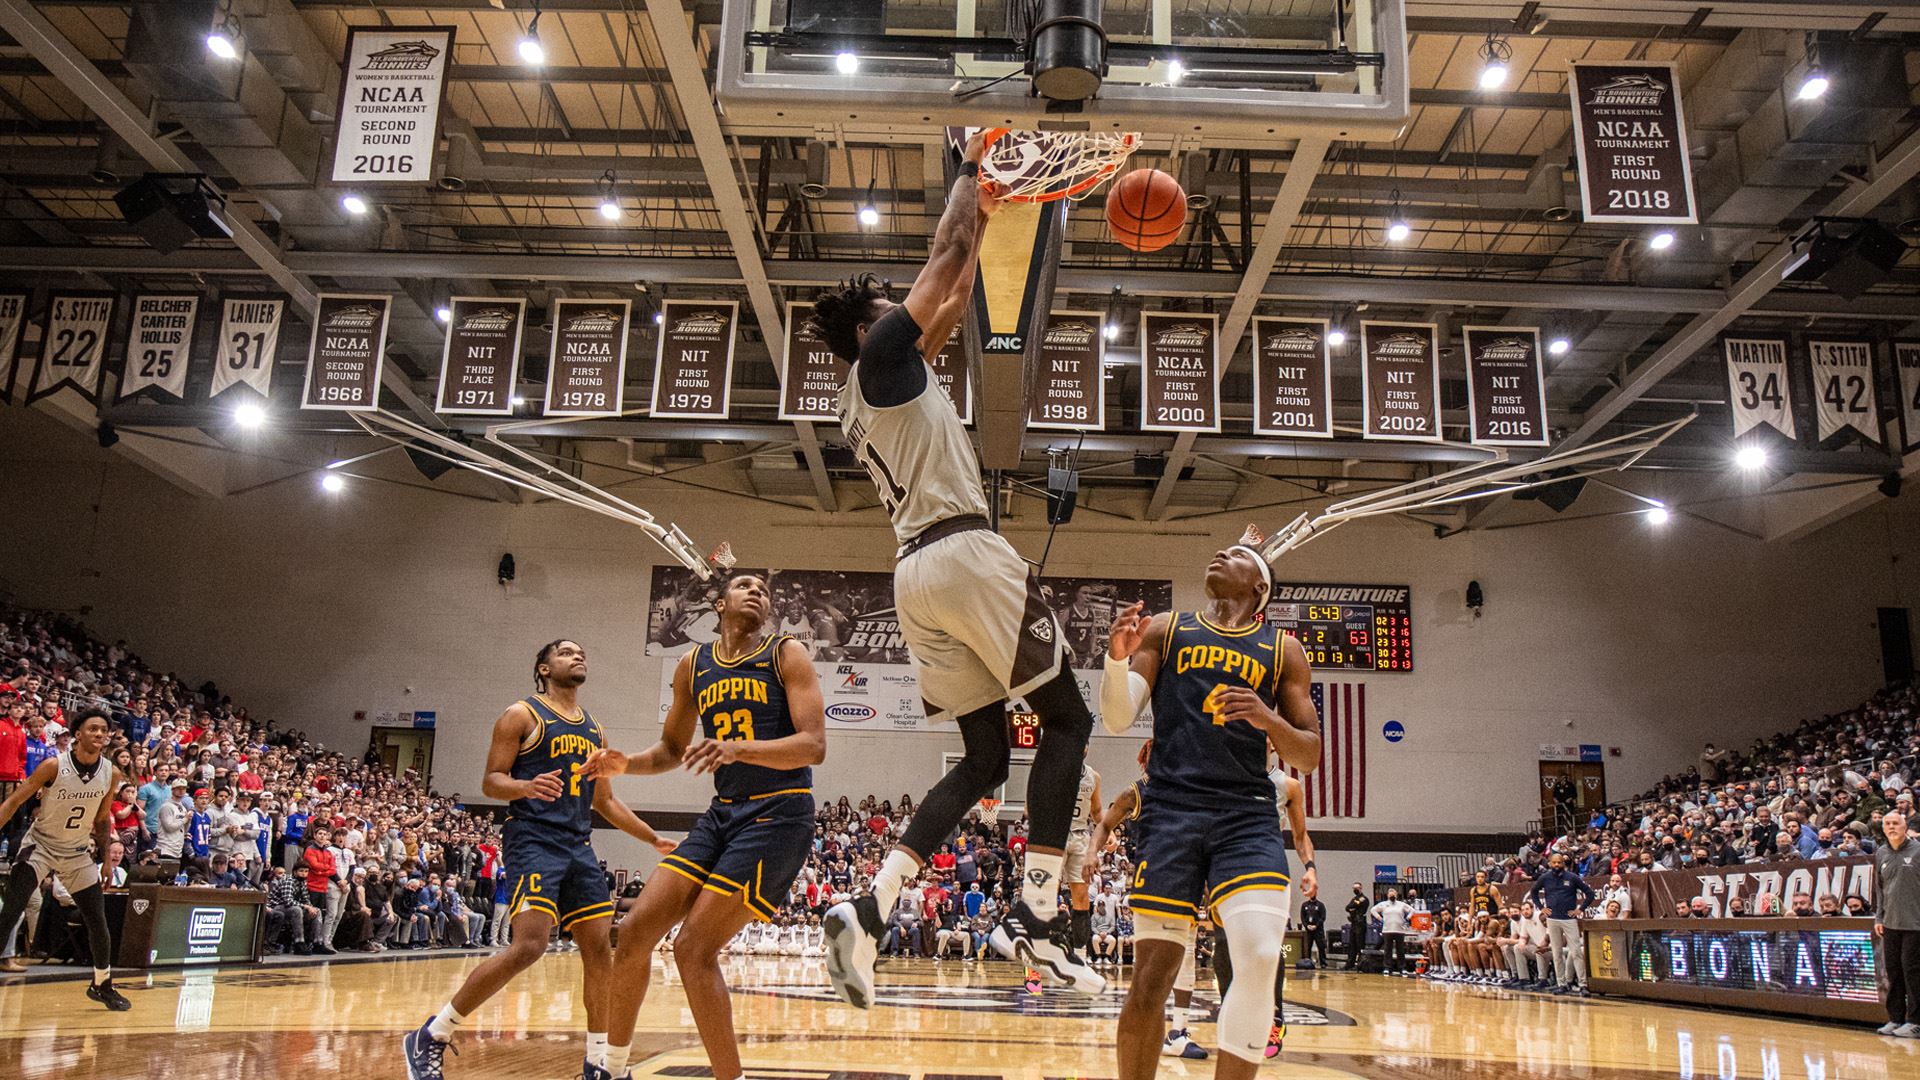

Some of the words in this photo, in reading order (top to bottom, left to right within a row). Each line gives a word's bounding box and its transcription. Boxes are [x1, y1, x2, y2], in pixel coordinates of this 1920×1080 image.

[367, 61, 429, 70] BONNIES
[360, 87, 424, 103] NCAA
[1594, 96, 1659, 104] BONNIES
[354, 105, 428, 113] TOURNAMENT
[361, 120, 416, 131] SECOND
[1597, 121, 1664, 138] NCAA
[362, 134, 411, 145] ROUND
[1594, 139, 1671, 149] TOURNAMENT
[353, 154, 414, 174] 2016
[1613, 155, 1656, 166] FIRST
[1611, 169, 1661, 180] ROUND
[1608, 189, 1671, 209] 2018
[54, 300, 67, 321] S.
[70, 301, 109, 322] STITH
[140, 300, 192, 313] BELCHER
[229, 302, 275, 324] LANIER
[140, 315, 187, 329] CARTER
[140, 330, 182, 344] HOLLIS
[325, 337, 369, 350] NCAA
[985, 336, 1022, 350] ANC
[51, 329, 97, 367] 22
[229, 331, 266, 370] 31
[467, 346, 496, 359] NIT
[566, 342, 611, 356] NCAA
[1729, 342, 1783, 364] MARTIN
[681, 350, 709, 362] NIT
[808, 352, 834, 364] NIT
[1814, 345, 1827, 366] T.
[1830, 345, 1868, 367] STITH
[139, 349, 174, 378] 25
[325, 361, 364, 371] SECOND
[1052, 359, 1081, 373] NIT
[1158, 356, 1204, 370] NCAA
[326, 372, 361, 381] ROUND
[465, 365, 495, 375] THIRD
[572, 367, 602, 376] FIRST
[678, 369, 709, 378] FIRST
[806, 371, 837, 381] FIRST
[1154, 369, 1208, 378] TOURNAMENT
[1278, 367, 1307, 380] NIT
[462, 375, 494, 384] PLACE
[568, 377, 603, 386] ROUND
[675, 379, 710, 389] ROUND
[1051, 379, 1081, 389] FIRST
[1386, 371, 1416, 384] NIT
[1492, 376, 1521, 389] NIT
[803, 381, 838, 391] ROUND
[1166, 382, 1196, 391] FIRST
[1278, 386, 1308, 396] FIRST
[1739, 371, 1784, 410] 34
[319, 386, 363, 401] 1968
[456, 390, 495, 405] 1971
[562, 392, 606, 407] 1978
[1048, 389, 1083, 399] ROUND
[1163, 392, 1199, 401] ROUND
[1386, 390, 1417, 400] FIRST
[1493, 395, 1522, 405] FIRST
[1824, 374, 1868, 413] 42
[668, 394, 712, 409] 1979
[797, 396, 839, 411] 1983
[1275, 396, 1311, 406] ROUND
[1384, 400, 1420, 410] ROUND
[1043, 404, 1088, 420] 1998
[1157, 407, 1206, 423] 2000
[1491, 405, 1526, 415] ROUND
[1271, 411, 1315, 428] 2001
[1380, 415, 1427, 432] 2002
[1488, 420, 1532, 436] 2016
[1309, 606, 1340, 620] 6:43
[1345, 622, 1367, 630] GUEST
[1376, 616, 1388, 626] 02
[1390, 617, 1396, 626] 3
[1403, 617, 1409, 626] 6
[1316, 631, 1325, 643] 2
[1350, 631, 1368, 645] 63
[1376, 627, 1388, 636] 04
[1390, 628, 1396, 636] 2
[1401, 628, 1410, 637] 16
[843, 632, 909, 648] BON
[1377, 638, 1389, 647] 23
[1391, 639, 1397, 647] 3
[1401, 638, 1410, 647] 15
[1317, 651, 1325, 663] 0
[1332, 651, 1343, 663] 13
[1365, 652, 1372, 664] 7
[1378, 649, 1389, 658] 30
[1391, 649, 1397, 658] 2
[1404, 649, 1410, 658] 2
[836, 665, 856, 674] KEL
[1176, 645, 1268, 691] COPPIN
[1377, 659, 1389, 669] 50
[1391, 660, 1398, 669] 0
[1402, 660, 1411, 669] 13
[698, 677, 768, 716] COPPIN
[1202, 683, 1229, 727] 4
[831, 707, 870, 717] mazza
[713, 708, 755, 741] 23
[1013, 714, 1039, 727] 6:43
[1018, 726, 1034, 746] 16
[570, 762, 582, 797] 2
[57, 788, 105, 800] Bonnies
[65, 805, 86, 829] 2
[198, 823, 210, 845] 17
[1134, 860, 1147, 888] C
[529, 873, 542, 893] C
[1749, 864, 1874, 918] BONA
